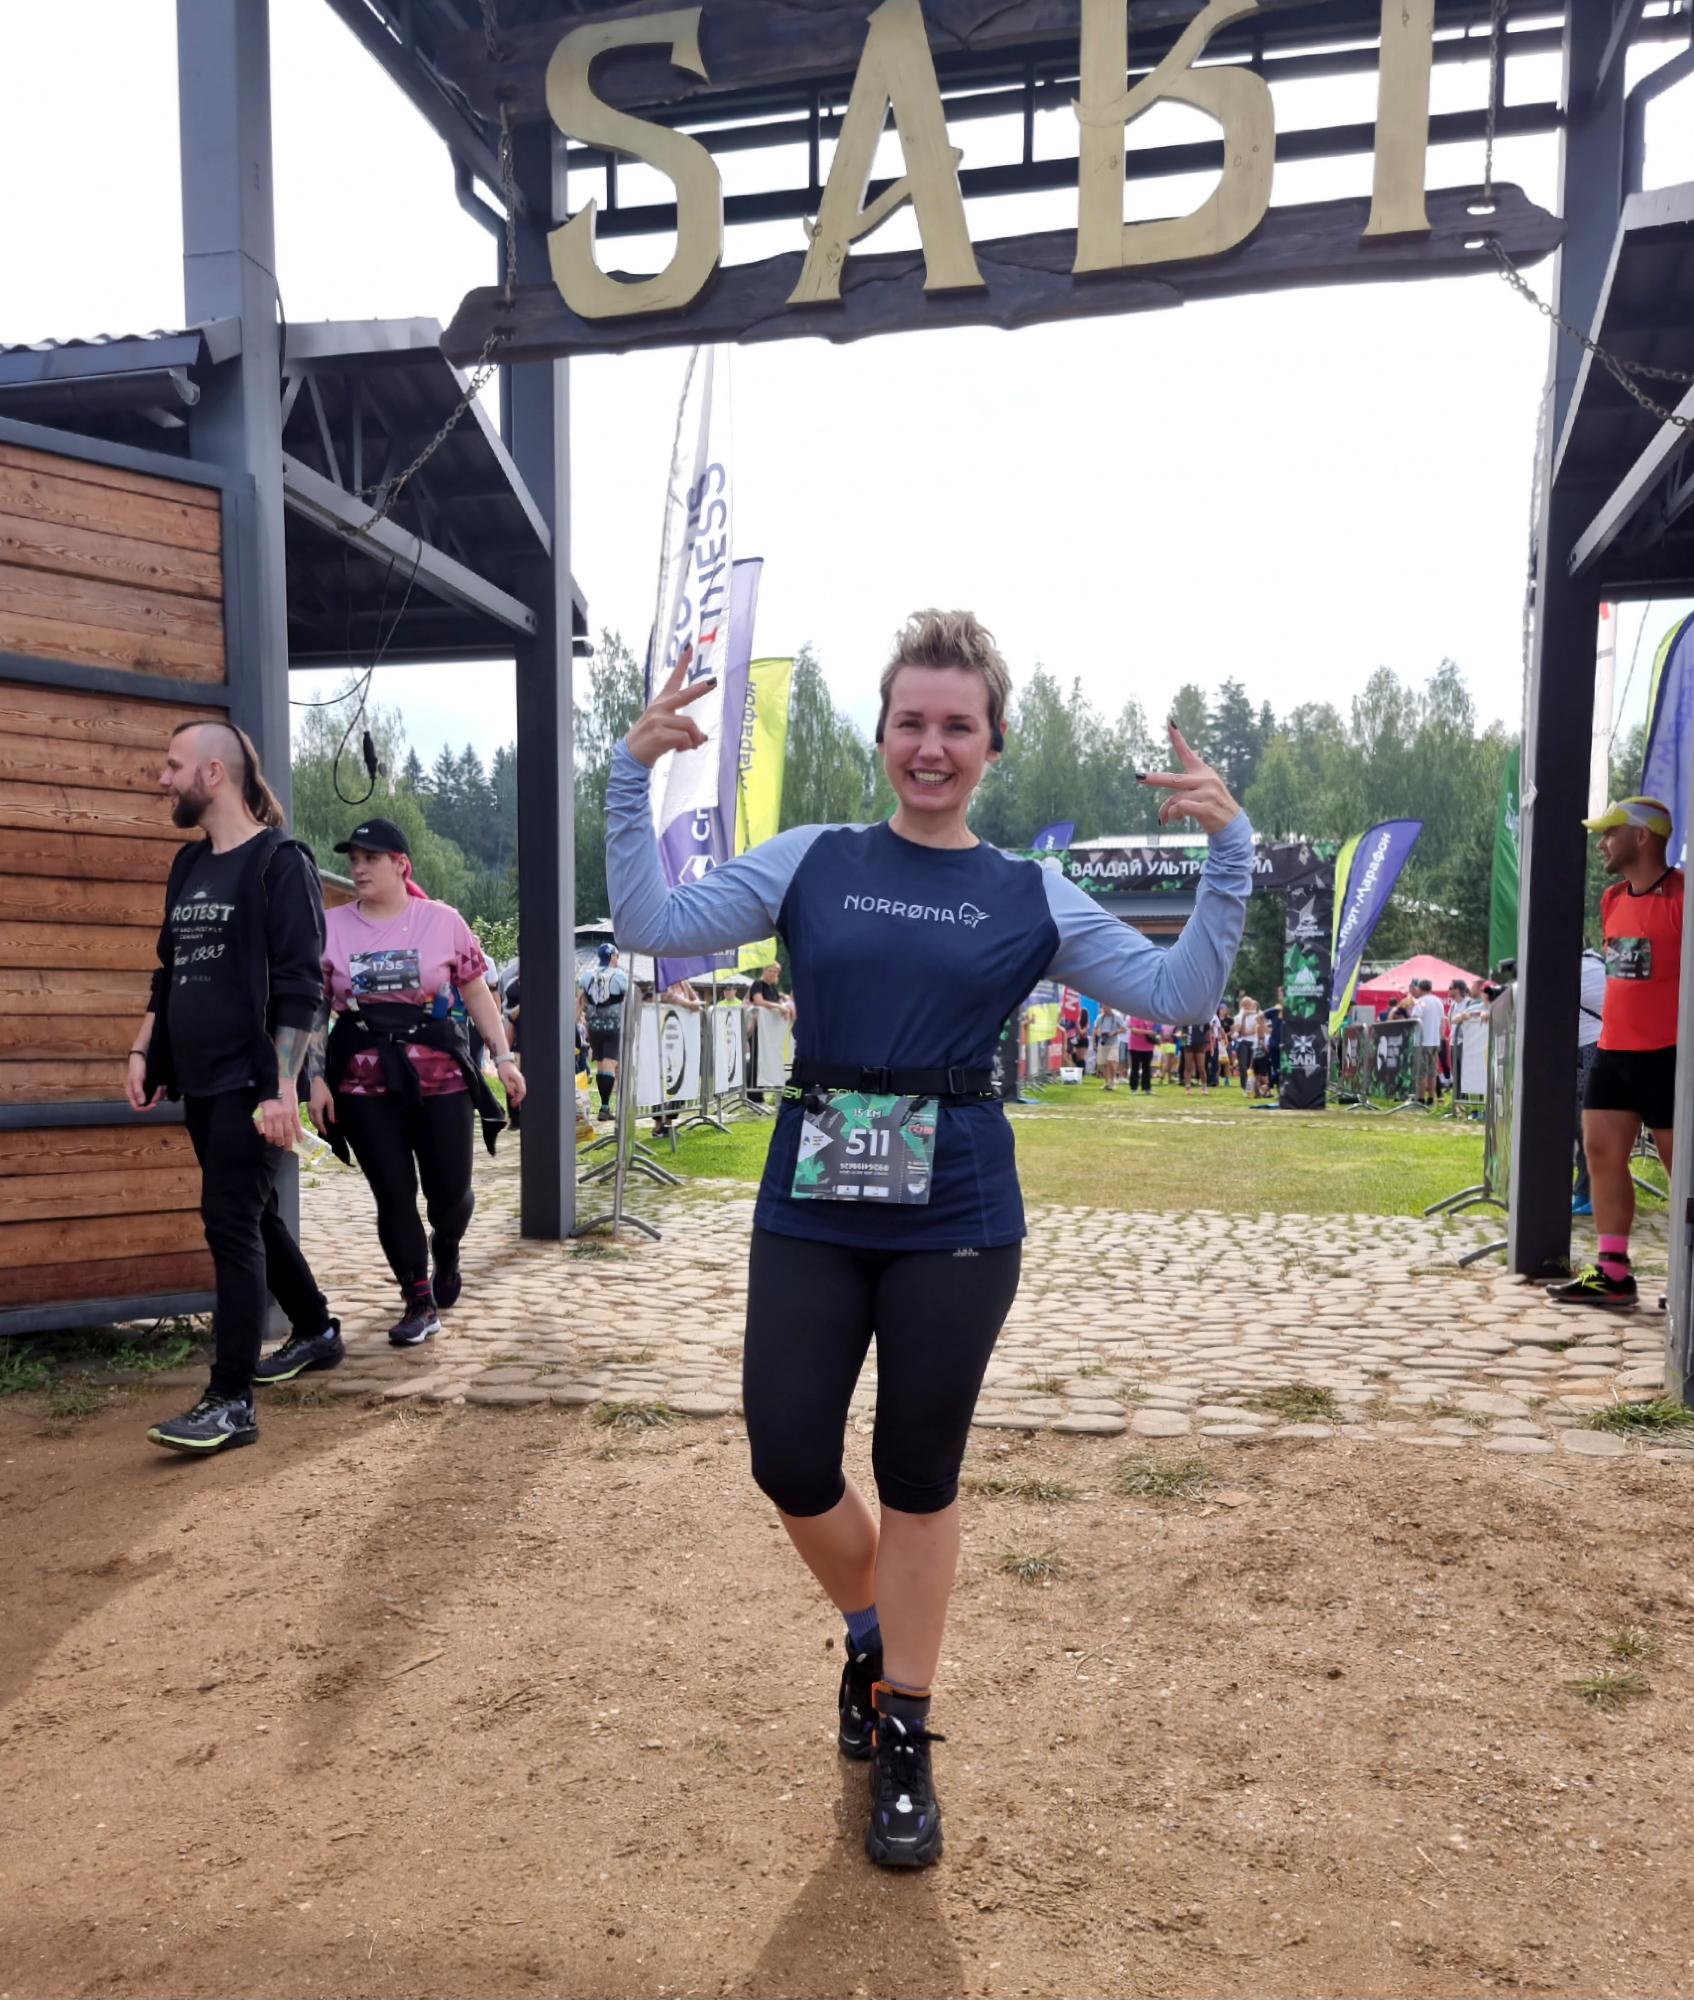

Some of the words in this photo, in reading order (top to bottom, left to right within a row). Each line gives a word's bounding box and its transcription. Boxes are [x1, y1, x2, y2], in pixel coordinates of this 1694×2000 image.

[1071, 858, 1142, 878] ВАЛДАЙ
[843, 894, 956, 925] NORRØNA
[845, 1128, 890, 1157] 511
